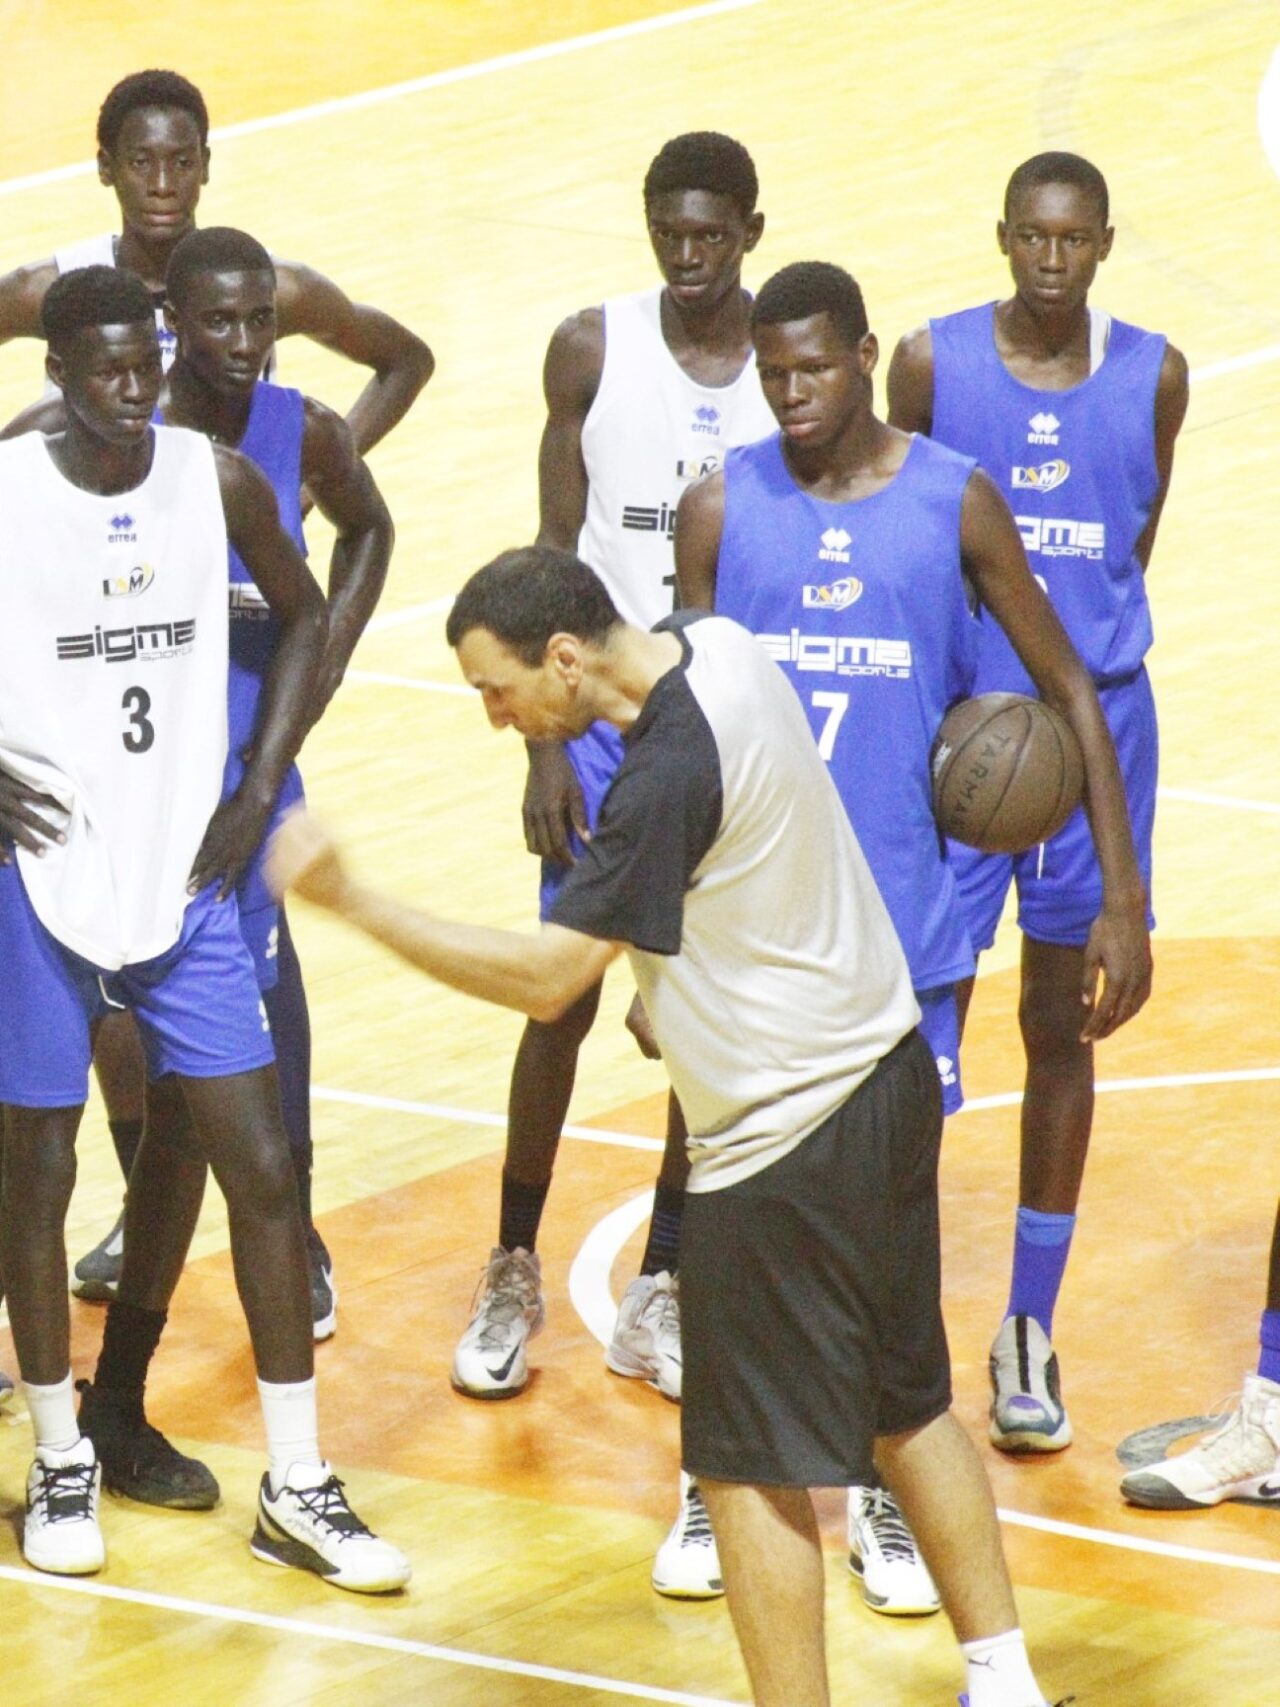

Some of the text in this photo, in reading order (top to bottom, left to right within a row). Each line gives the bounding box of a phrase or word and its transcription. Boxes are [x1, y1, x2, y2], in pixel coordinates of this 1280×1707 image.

[57, 617, 196, 664] sigma
[755, 628, 912, 673] sigma
[837, 664, 911, 679] sports
[122, 685, 155, 754] 3
[812, 691, 849, 761] 7
